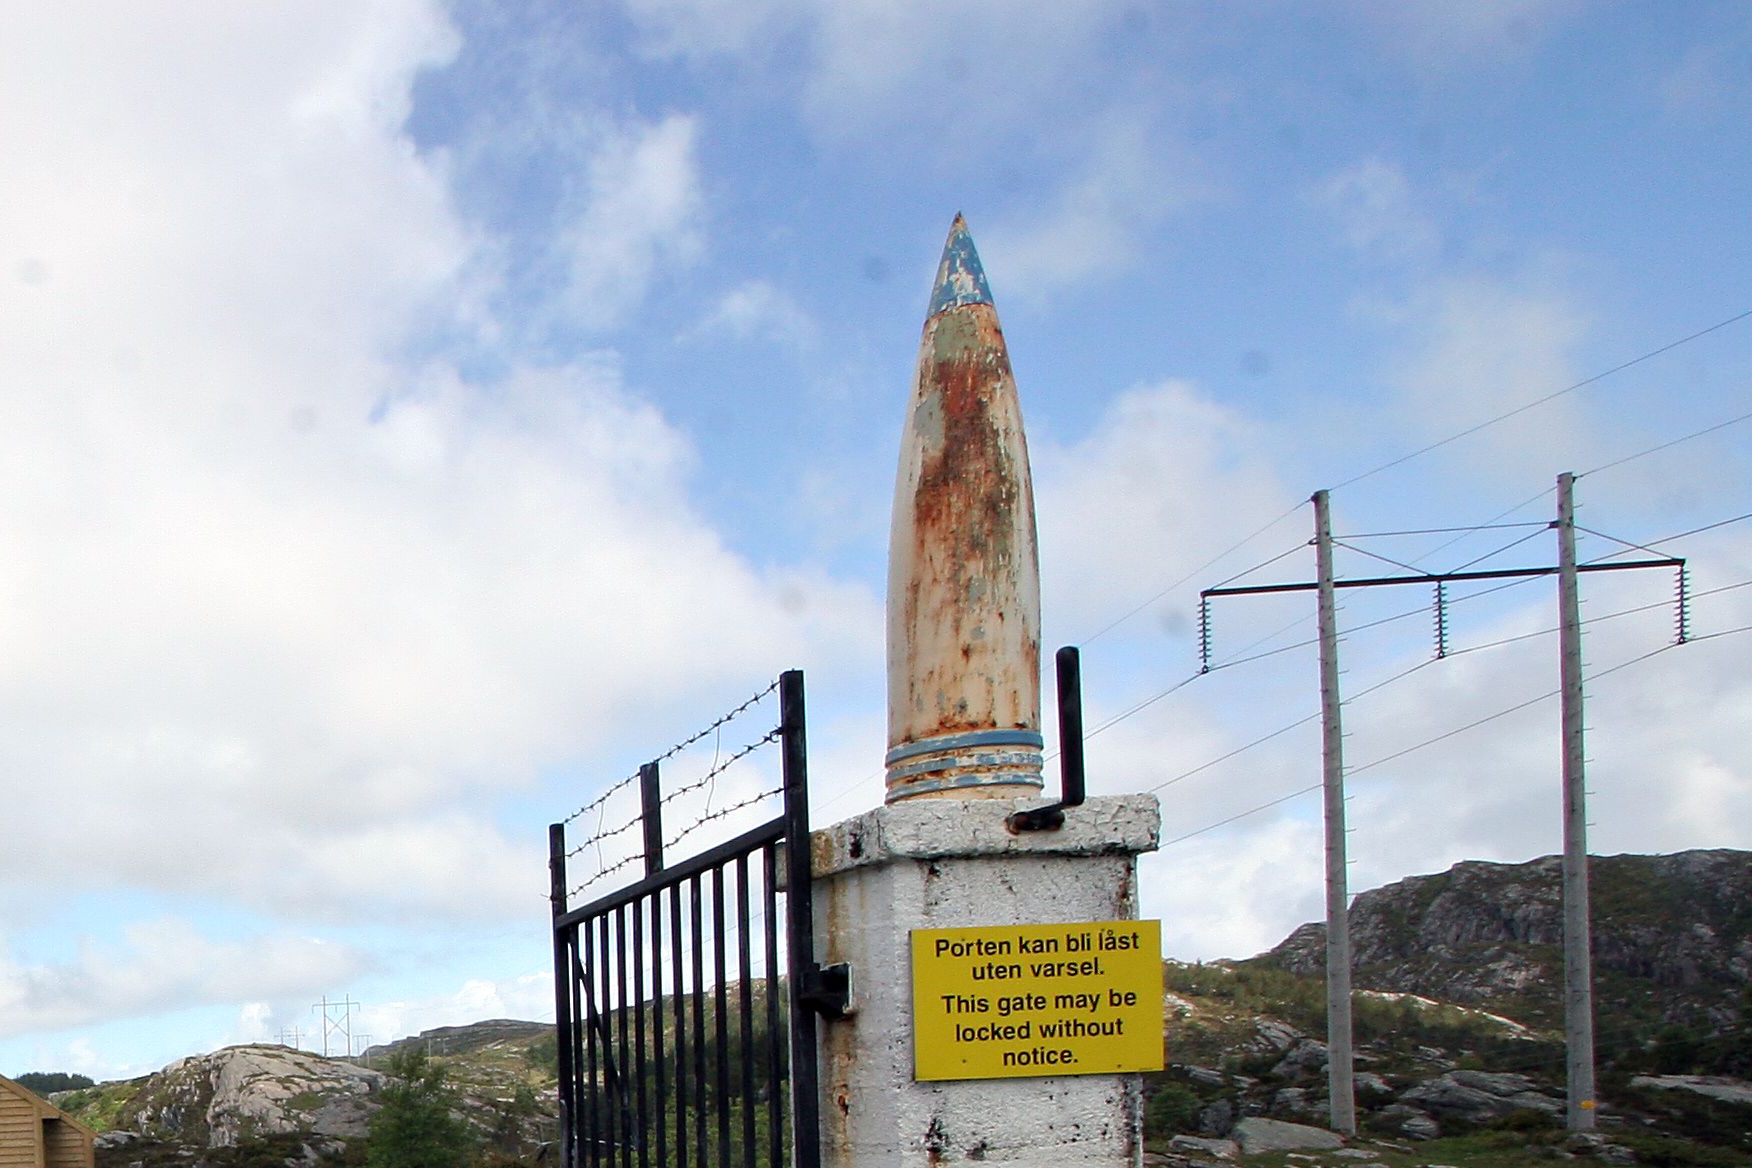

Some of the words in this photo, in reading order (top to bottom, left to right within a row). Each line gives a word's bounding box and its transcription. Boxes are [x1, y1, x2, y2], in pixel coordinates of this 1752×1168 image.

[935, 938, 1011, 958] Porten
[1018, 935, 1059, 955] kan
[1066, 932, 1091, 952] bli
[1099, 930, 1140, 951] låst
[972, 962, 1022, 980] uten
[1031, 957, 1104, 978] varsel.
[941, 994, 990, 1014] This
[998, 993, 1046, 1017] gate
[1054, 993, 1100, 1012] may
[1109, 989, 1137, 1007] be
[956, 1021, 1030, 1042] locked
[1039, 1018, 1123, 1038] without
[1003, 1047, 1078, 1066] notice.
